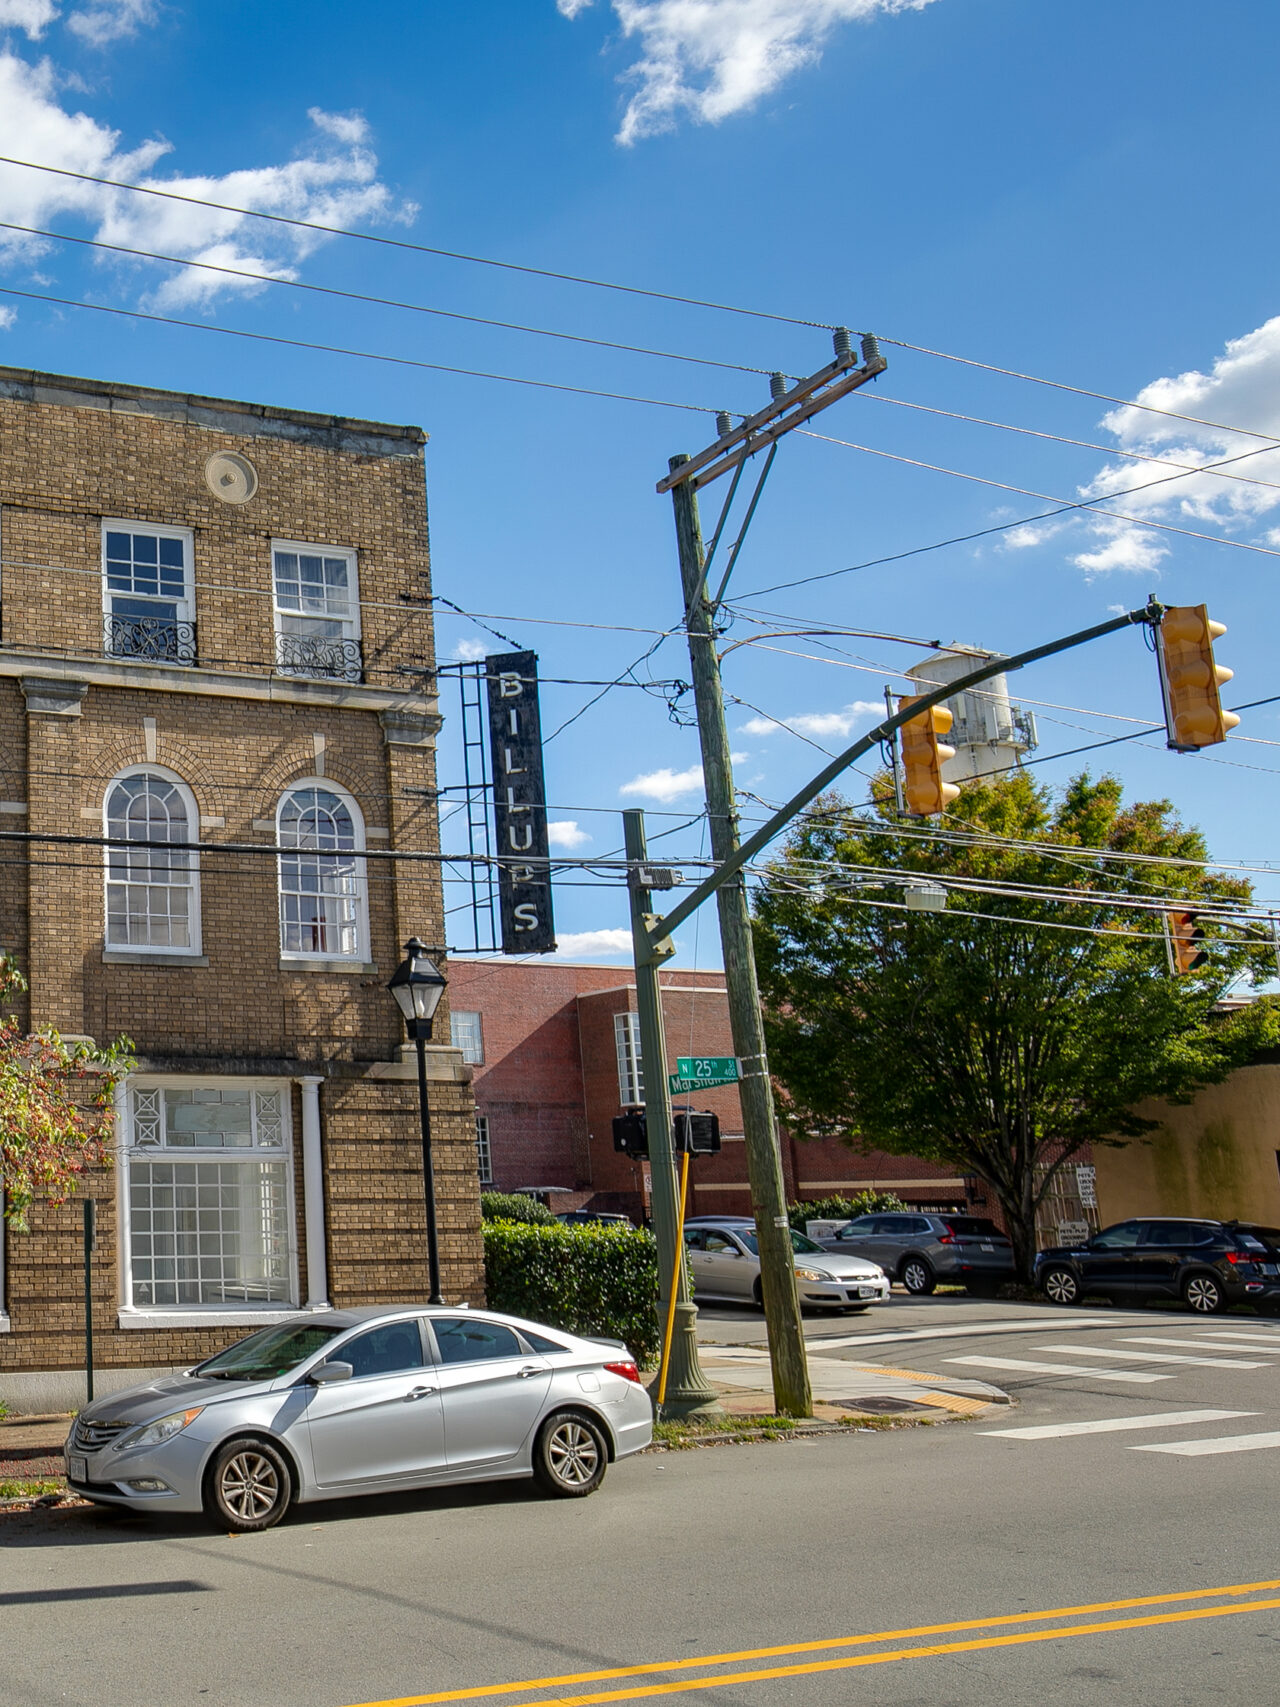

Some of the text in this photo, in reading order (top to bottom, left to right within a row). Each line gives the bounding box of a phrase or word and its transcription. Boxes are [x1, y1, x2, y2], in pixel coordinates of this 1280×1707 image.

[499, 671, 539, 932] BILLUPS
[682, 1064, 688, 1073] N
[695, 1060, 717, 1076] 25th
[724, 1068, 736, 1076] 400
[671, 1076, 720, 1092] Mars
